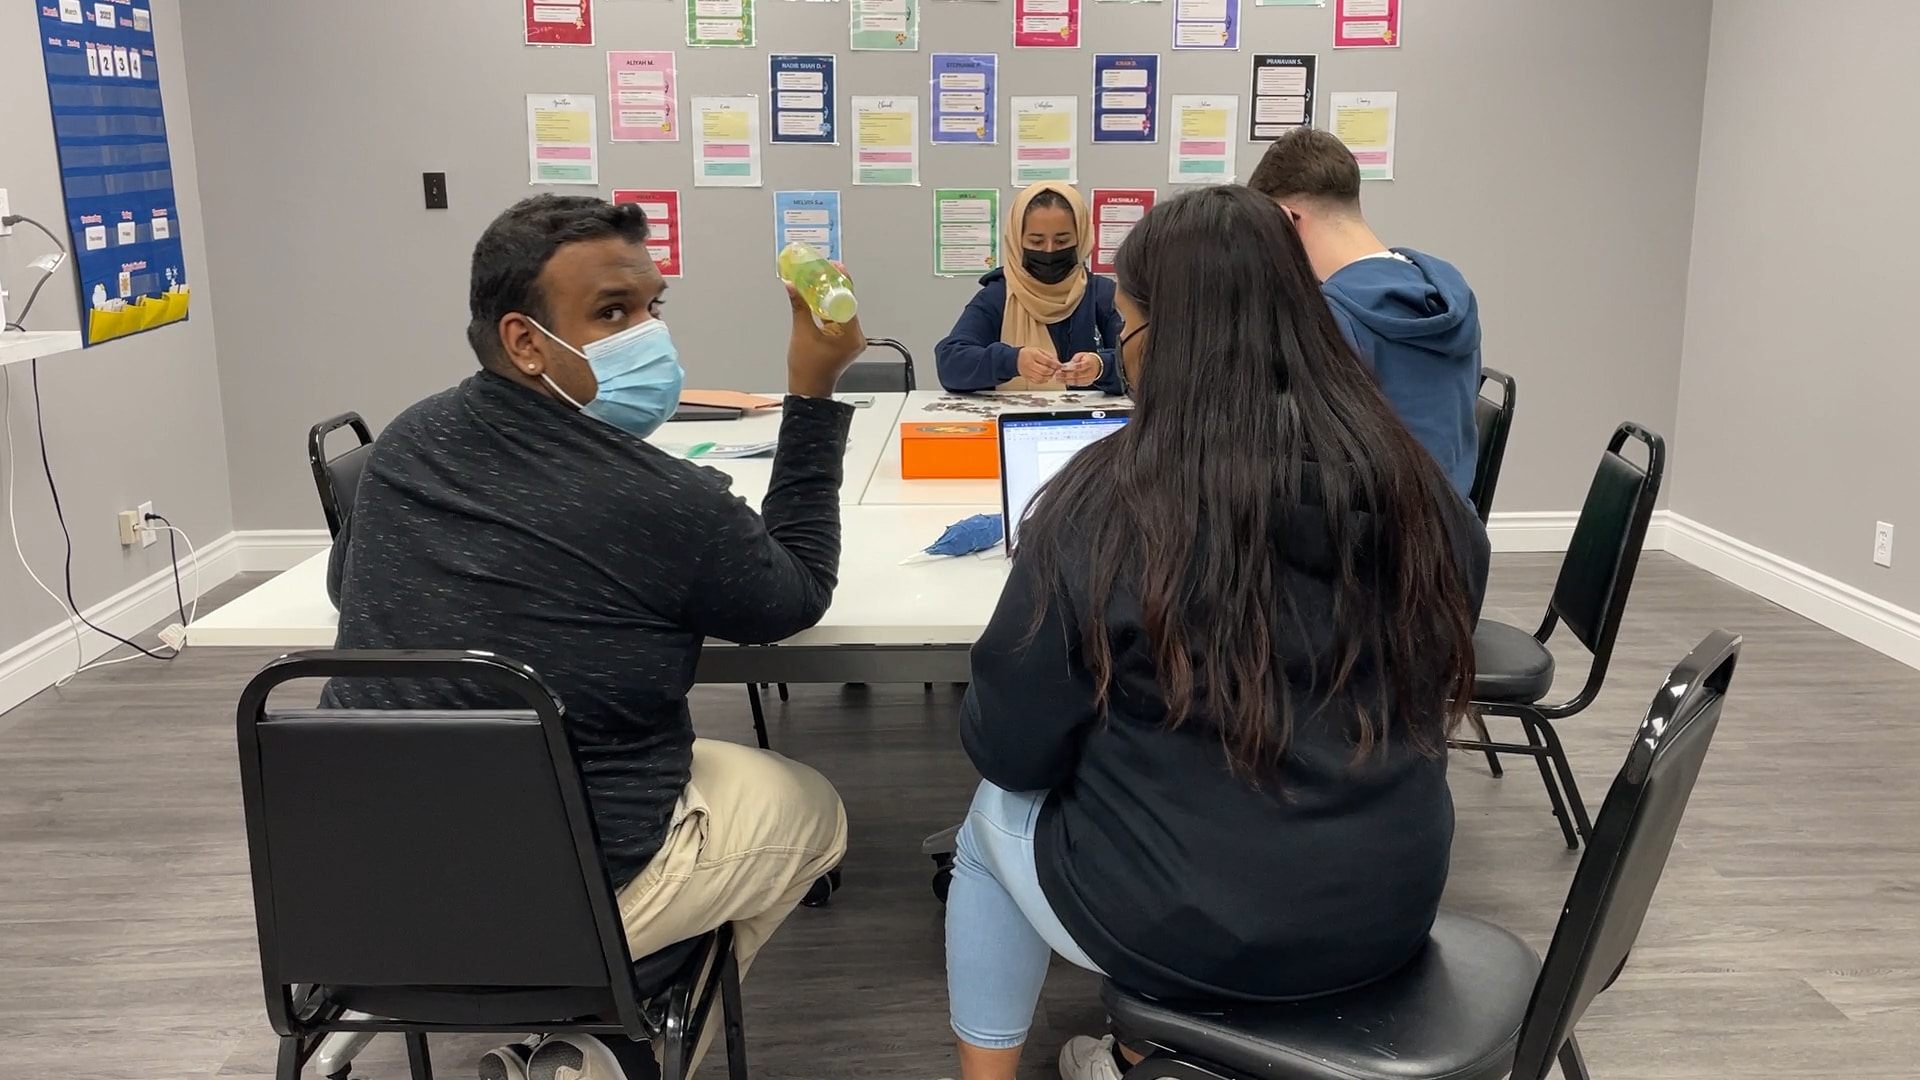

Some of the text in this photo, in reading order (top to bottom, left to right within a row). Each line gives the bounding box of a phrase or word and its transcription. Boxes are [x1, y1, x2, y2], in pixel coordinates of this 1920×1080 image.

[91, 55, 138, 71] 1 2 3 4
